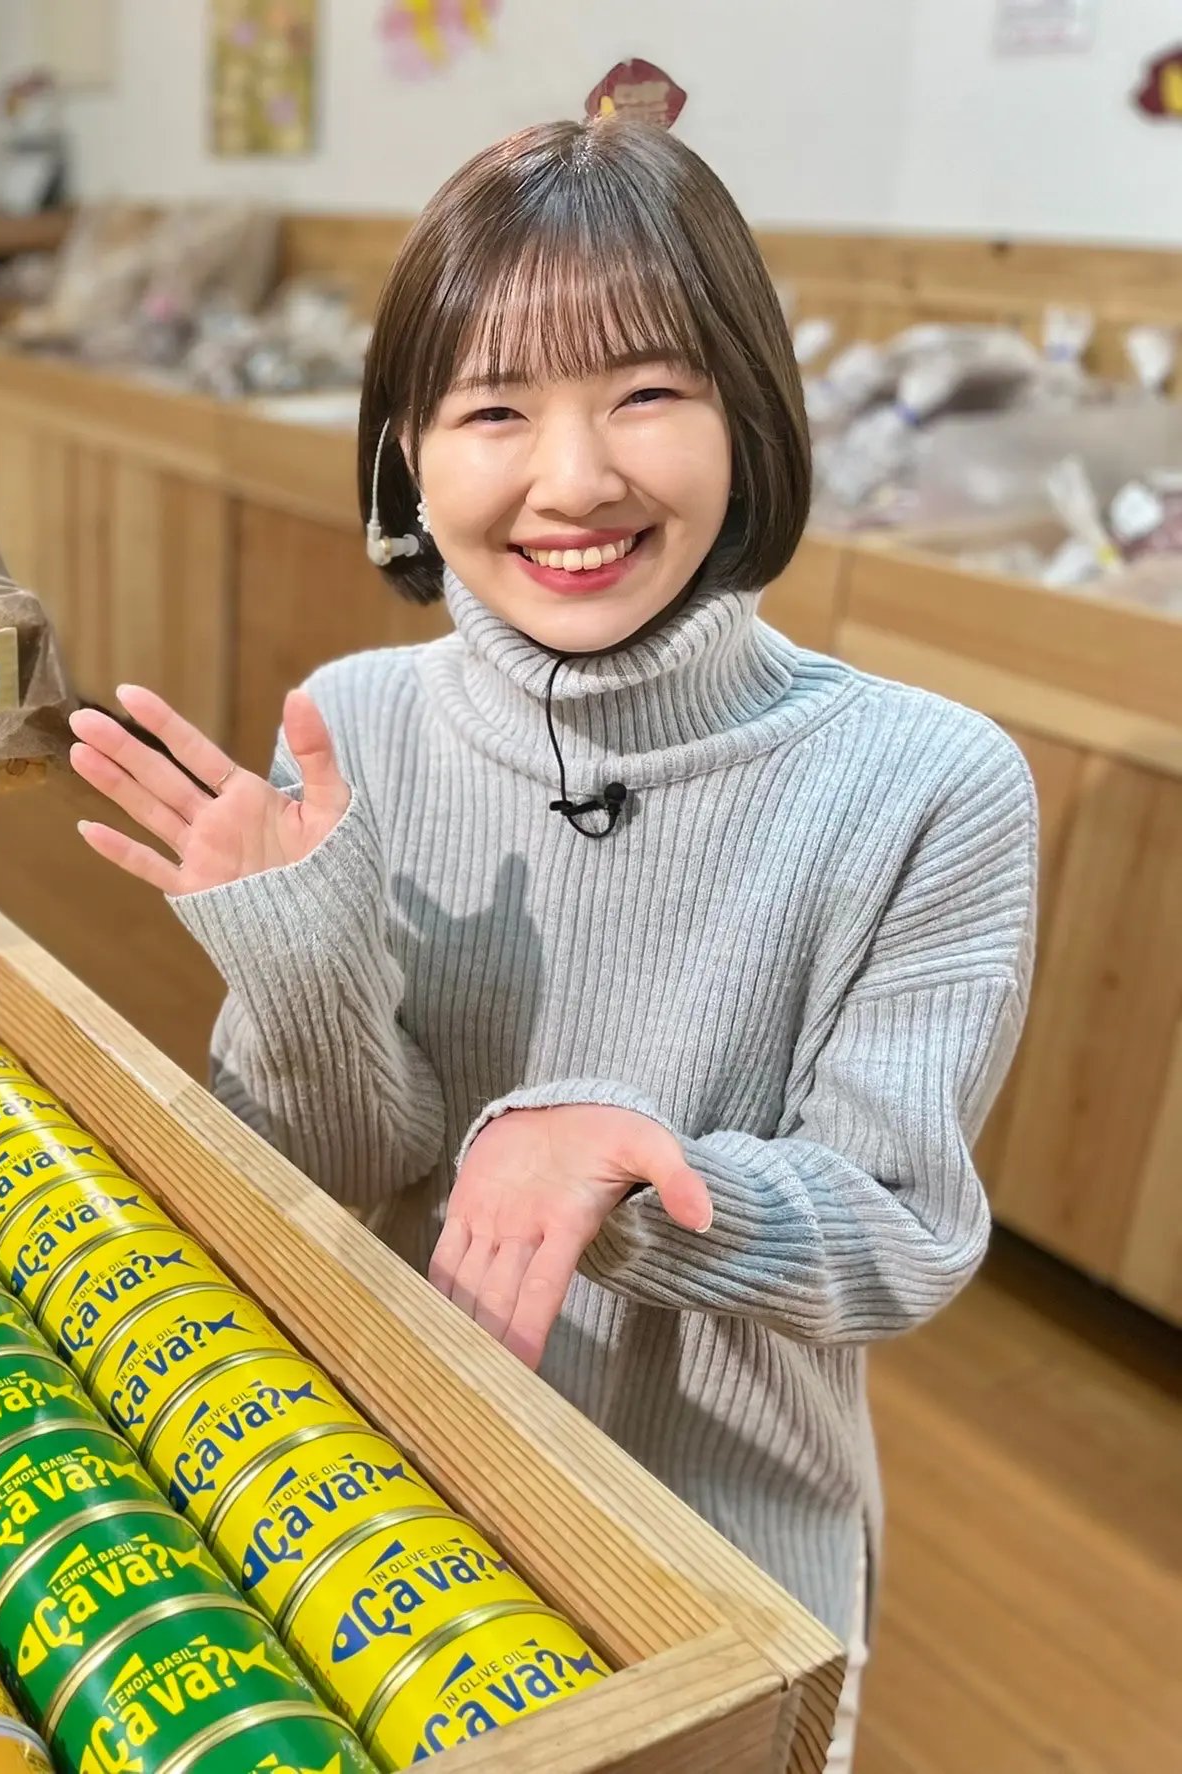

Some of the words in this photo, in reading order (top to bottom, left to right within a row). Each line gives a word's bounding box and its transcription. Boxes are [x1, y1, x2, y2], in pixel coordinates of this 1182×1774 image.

[38, 1206, 65, 1228] OLIVE
[70, 1301, 79, 1312] IN
[80, 1271, 107, 1298] OLIVE
[108, 1260, 127, 1272] OIL
[118, 1372, 128, 1384] IN
[128, 1342, 154, 1371] OLIVE
[156, 1328, 177, 1341] OIL
[185, 1437, 197, 1448] IN
[197, 1405, 229, 1434] OLIVE
[231, 1392, 252, 1405] OIL
[40, 1452, 79, 1471] BASIL
[268, 1500, 281, 1514] IN
[282, 1472, 319, 1500] OLIVE
[321, 1462, 343, 1475] OIL
[52, 1557, 97, 1596] LEMON
[97, 1540, 140, 1562] BASIL
[372, 1571, 388, 1586] IN
[389, 1549, 429, 1574] OLIVE
[430, 1543, 454, 1554] OIL
[109, 1669, 153, 1715] LEMON
[153, 1647, 198, 1674] BASIL
[442, 1696, 459, 1710] IN
[459, 1664, 501, 1694] OLIVE
[503, 1651, 529, 1666] OIL
